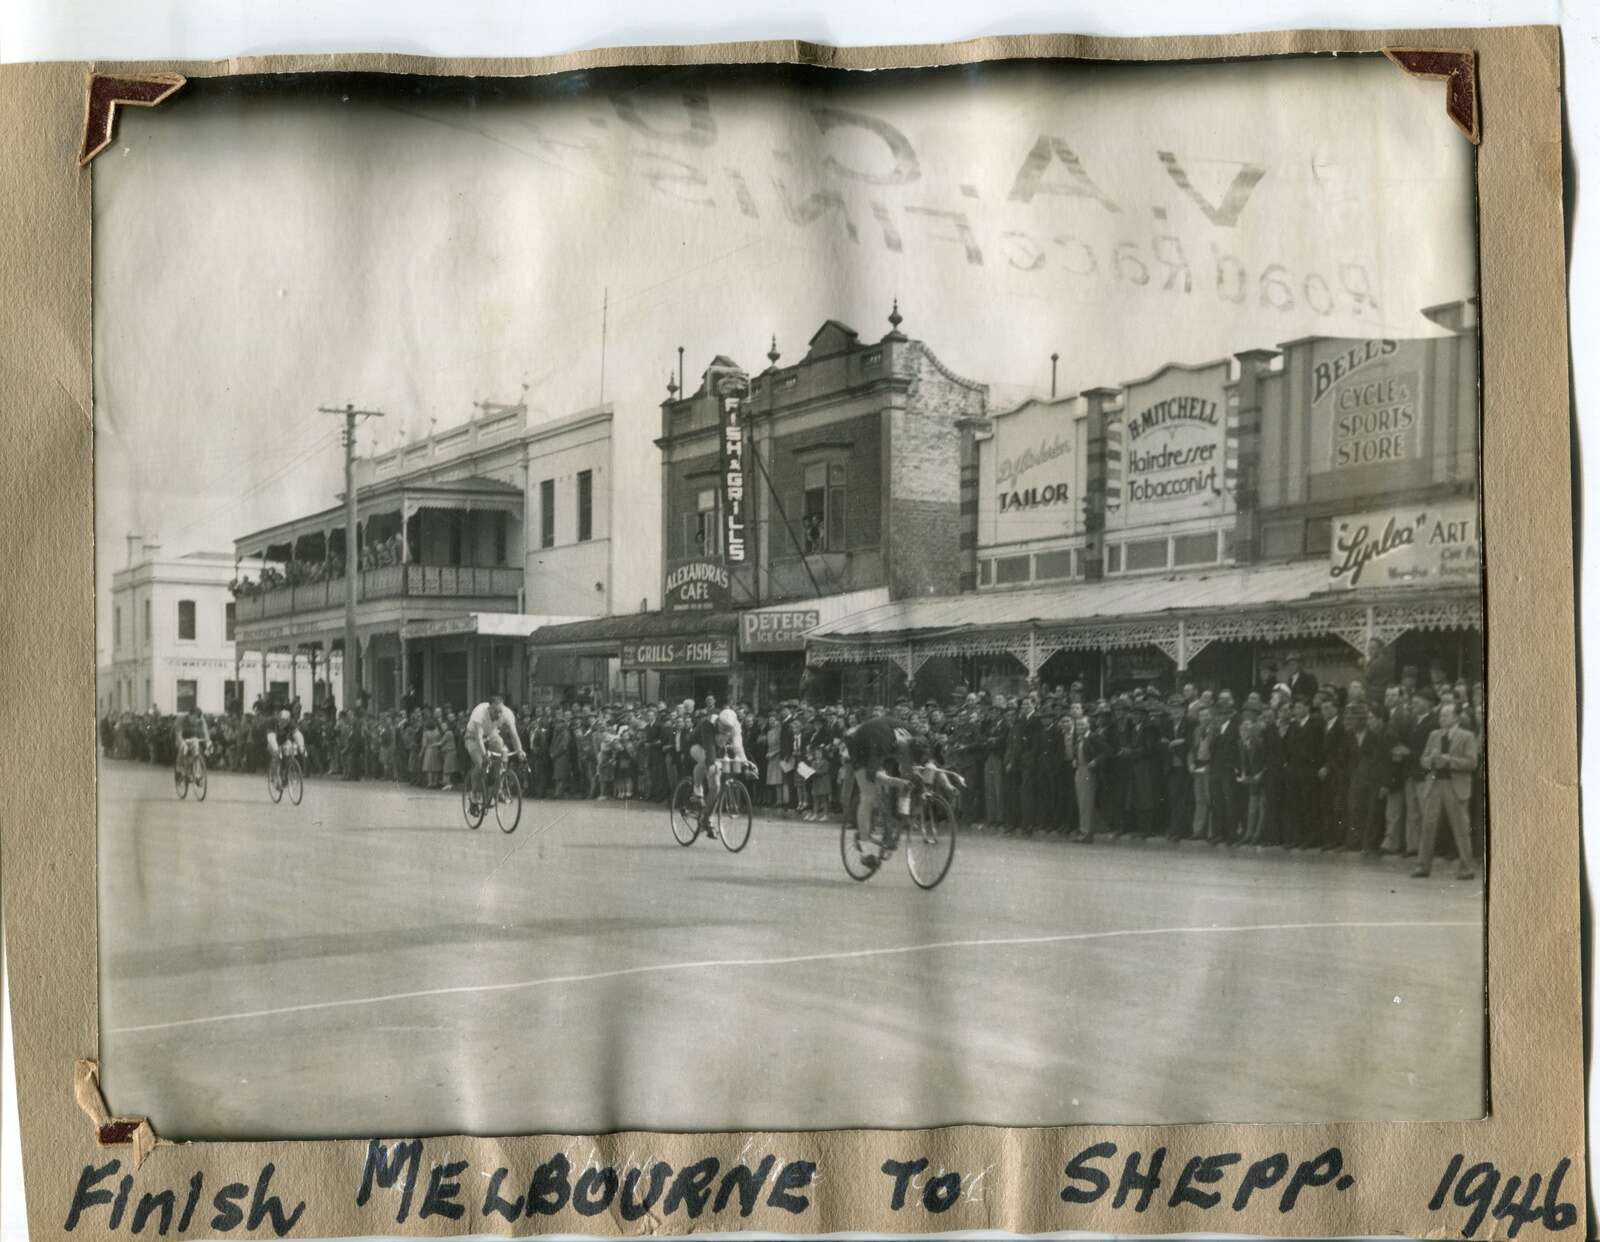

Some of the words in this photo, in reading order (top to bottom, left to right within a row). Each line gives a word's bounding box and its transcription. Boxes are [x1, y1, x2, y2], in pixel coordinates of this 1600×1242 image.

[1339, 380, 1395, 410] CYCLE
[724, 398, 742, 456] FISH
[1141, 396, 1220, 433] MITCHELL
[1338, 406, 1413, 439] SPORTS
[1129, 443, 1217, 475] Hairdresser
[1336, 434, 1403, 467] STORE
[998, 483, 1069, 513] TAILOR
[1128, 466, 1222, 502] Tobacconist
[726, 472, 745, 562] GRILLS
[1429, 519, 1469, 545] ART
[665, 562, 729, 594] ALEXANDRA'S
[680, 583, 709, 600] CAFE
[743, 612, 818, 647] PETERS
[637, 644, 674, 663] GRILLS
[686, 643, 712, 661] FISH
[356, 1138, 817, 1224] MELBOURNE
[1061, 1142, 1356, 1214] SHEPP.
[1427, 1153, 1578, 1239] 1946
